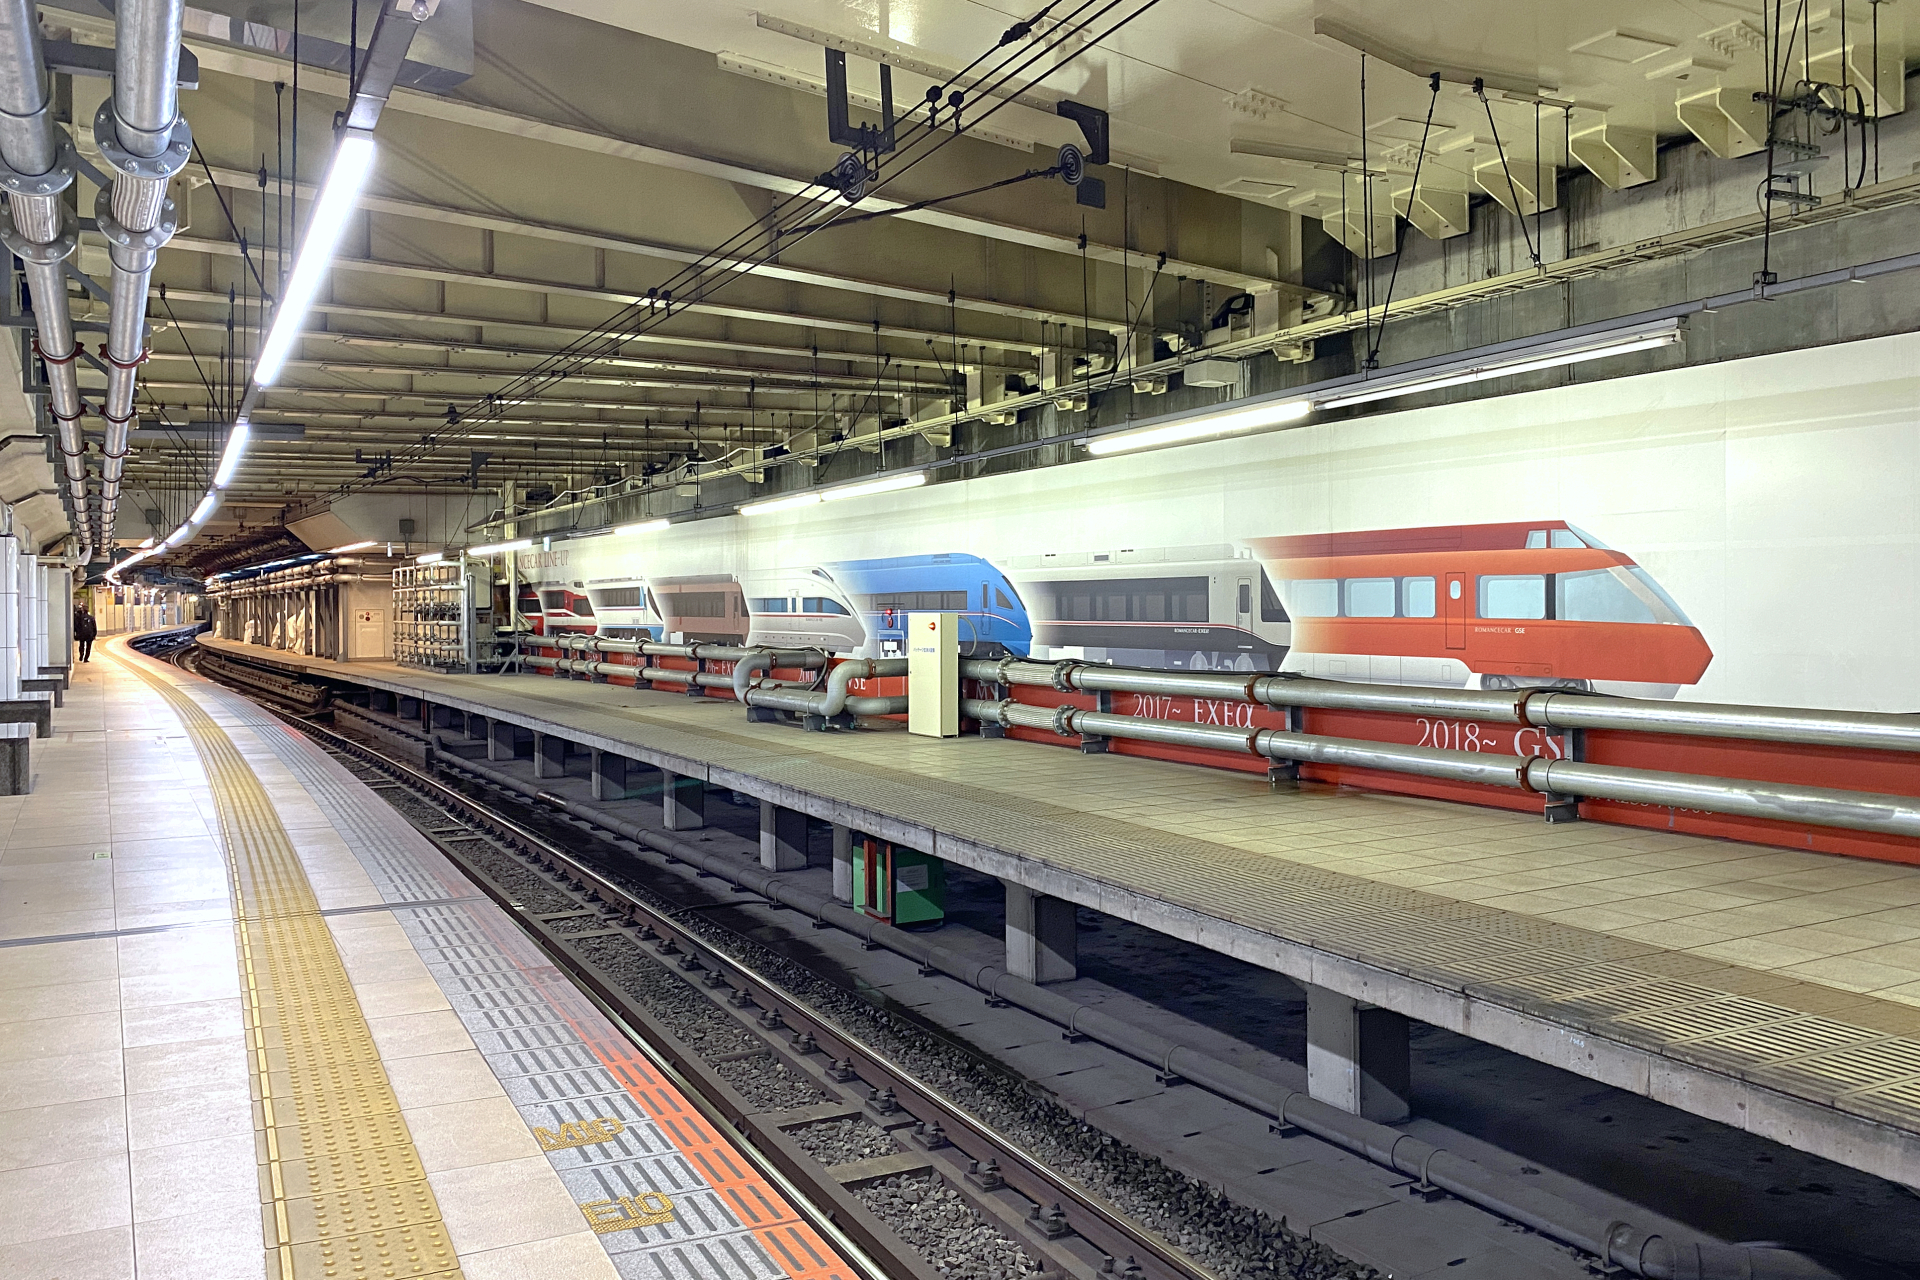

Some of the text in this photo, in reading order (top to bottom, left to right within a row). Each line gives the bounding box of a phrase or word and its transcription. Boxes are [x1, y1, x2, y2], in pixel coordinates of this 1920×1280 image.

[1133, 693, 1181, 720] 2017~
[1416, 718, 1562, 760] 2018~ GS
[533, 1117, 626, 1147] M10
[579, 1191, 674, 1226] E10
